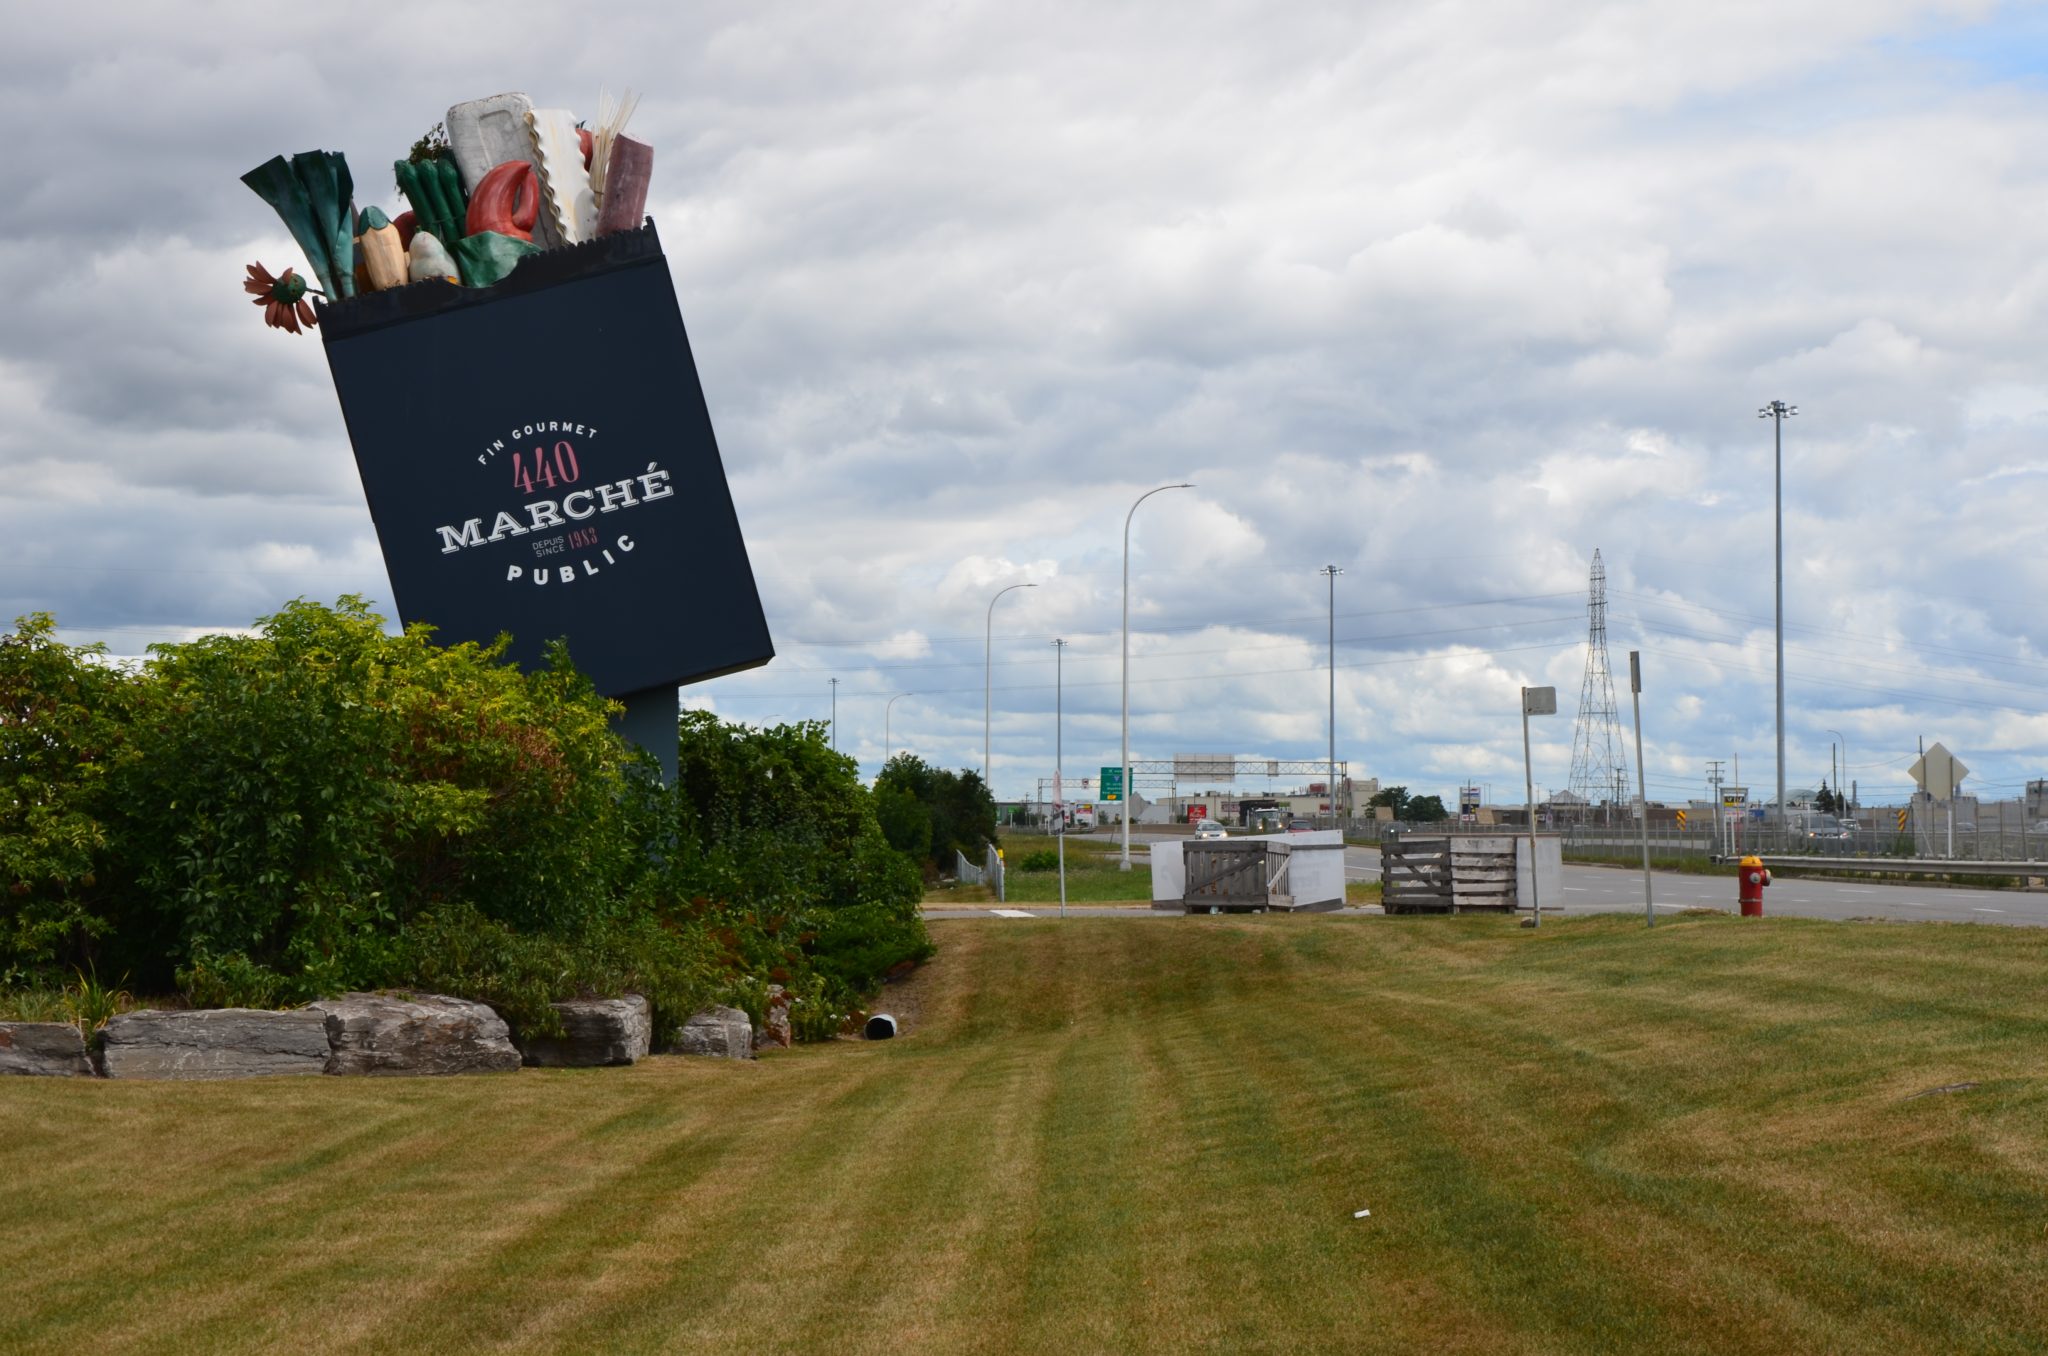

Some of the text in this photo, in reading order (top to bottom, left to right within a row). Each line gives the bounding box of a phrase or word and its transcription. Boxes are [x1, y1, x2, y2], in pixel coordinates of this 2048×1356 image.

[478, 421, 598, 466] FIN GOURMET
[513, 440, 580, 495] 440
[436, 461, 675, 555] MARCHÉ
[507, 534, 635, 586] PUBLIC
[532, 526, 598, 551] DEPUIS 1983
[535, 545, 566, 558] SINCE
